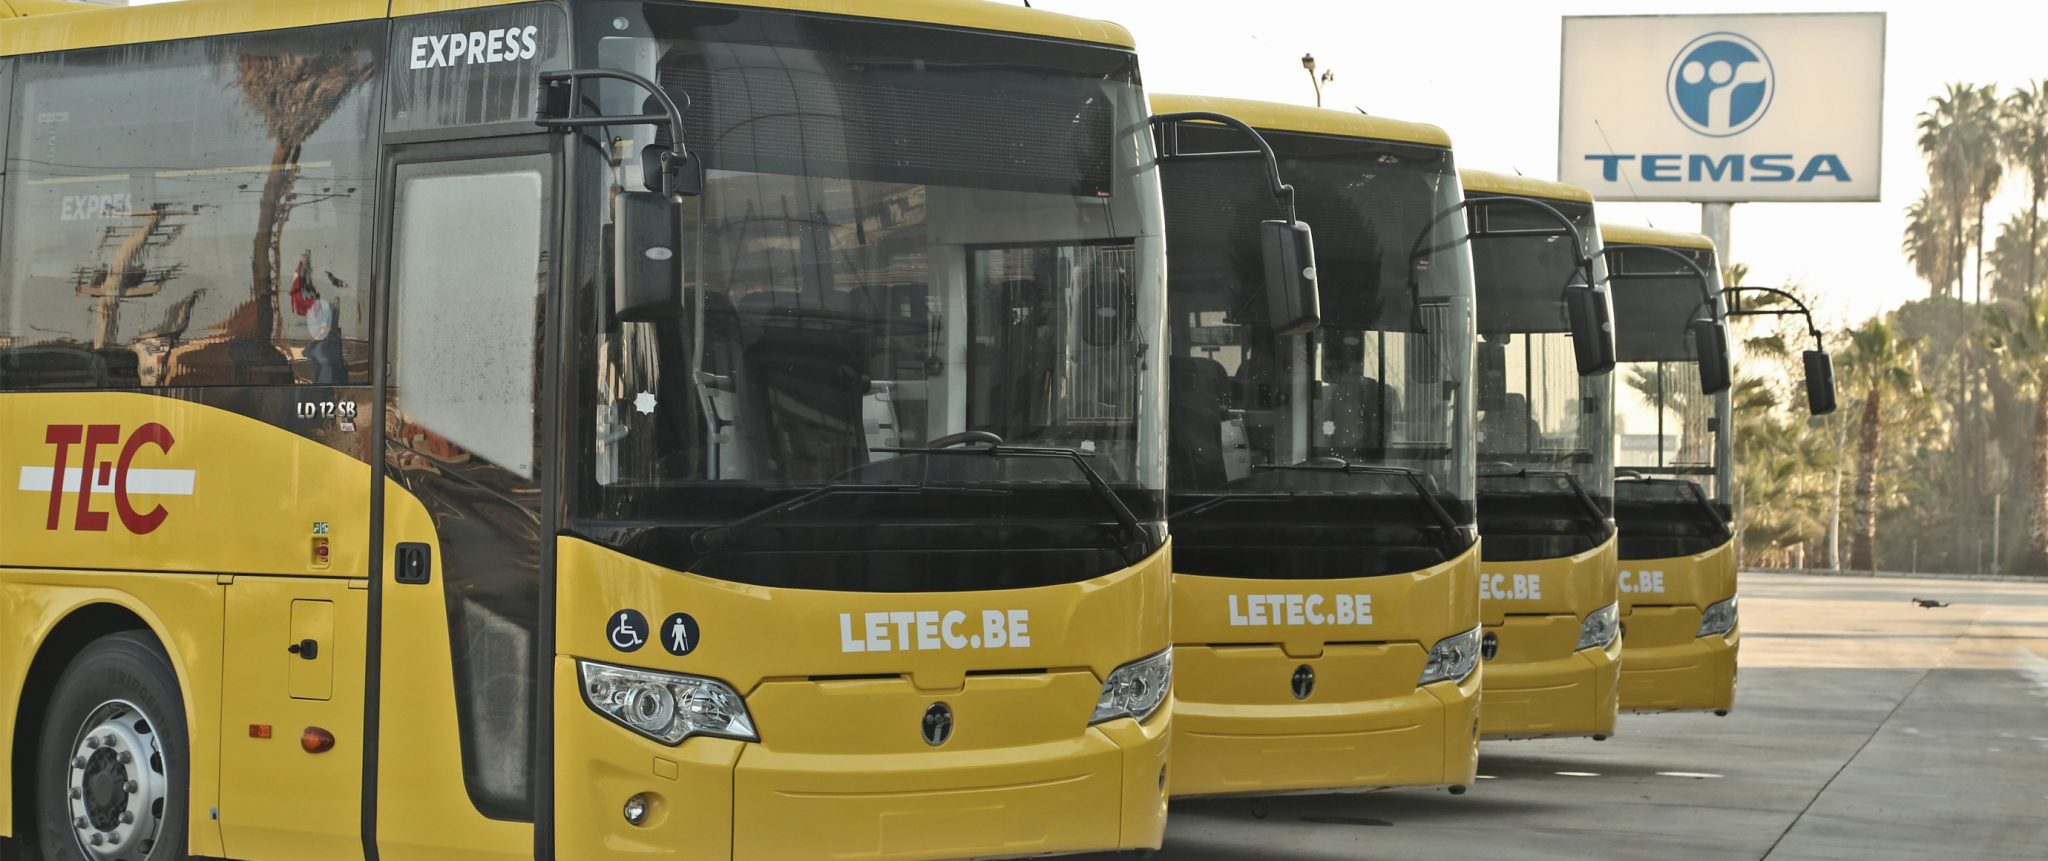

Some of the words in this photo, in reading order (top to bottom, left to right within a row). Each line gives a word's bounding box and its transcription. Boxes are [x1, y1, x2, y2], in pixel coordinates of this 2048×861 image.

[410, 25, 538, 69] EXPRESS
[1584, 153, 1852, 182] TEMSA
[297, 402, 316, 419] LD
[320, 401, 335, 419] 12
[338, 401, 356, 418] SB
[45, 422, 175, 535] TEC
[1480, 573, 1541, 600] EC.BE
[1618, 570, 1665, 593] C.BE
[1228, 595, 1373, 625] LETEC.BE
[841, 609, 1031, 653] LETEC.BE
